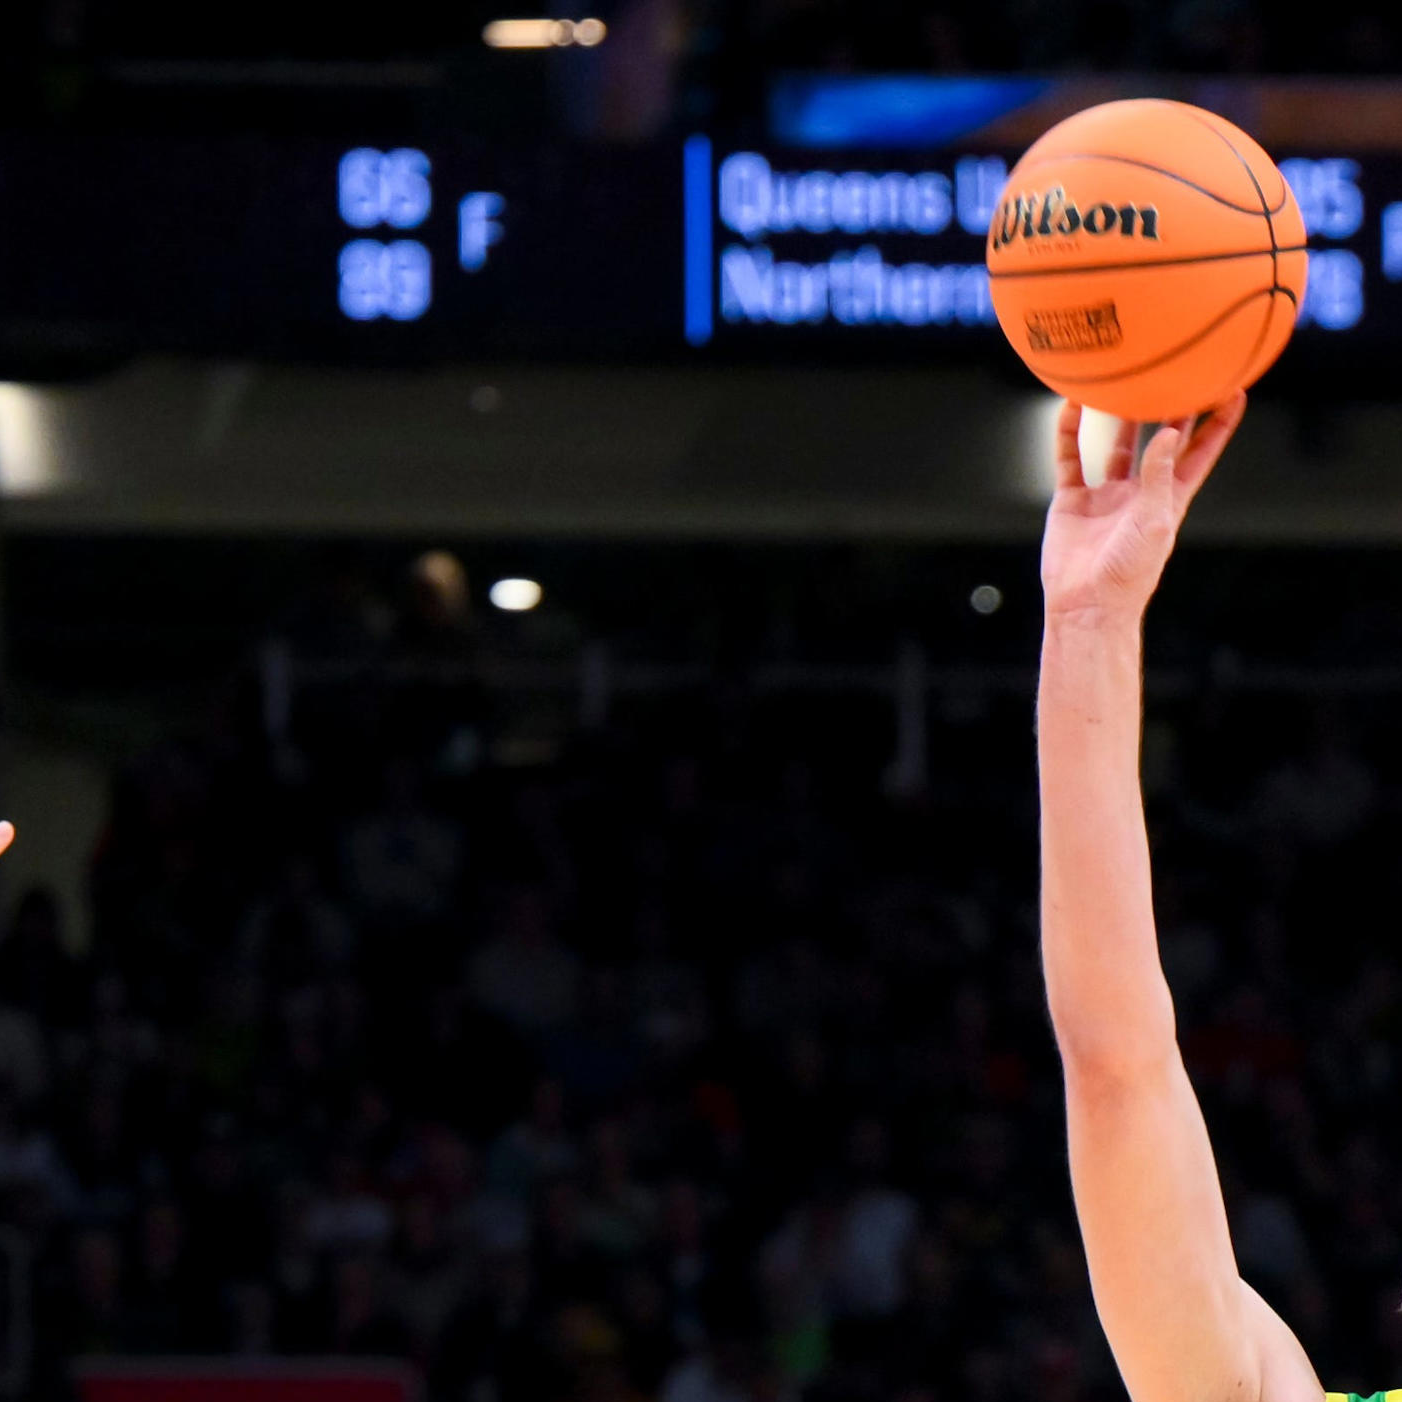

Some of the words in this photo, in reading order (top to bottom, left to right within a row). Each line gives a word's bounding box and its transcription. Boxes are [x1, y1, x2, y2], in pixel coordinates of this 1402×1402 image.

[459, 191, 502, 270] F
[719, 151, 953, 240] Queens
[992, 186, 1162, 252] Wilson
[721, 246, 997, 327] Northern
